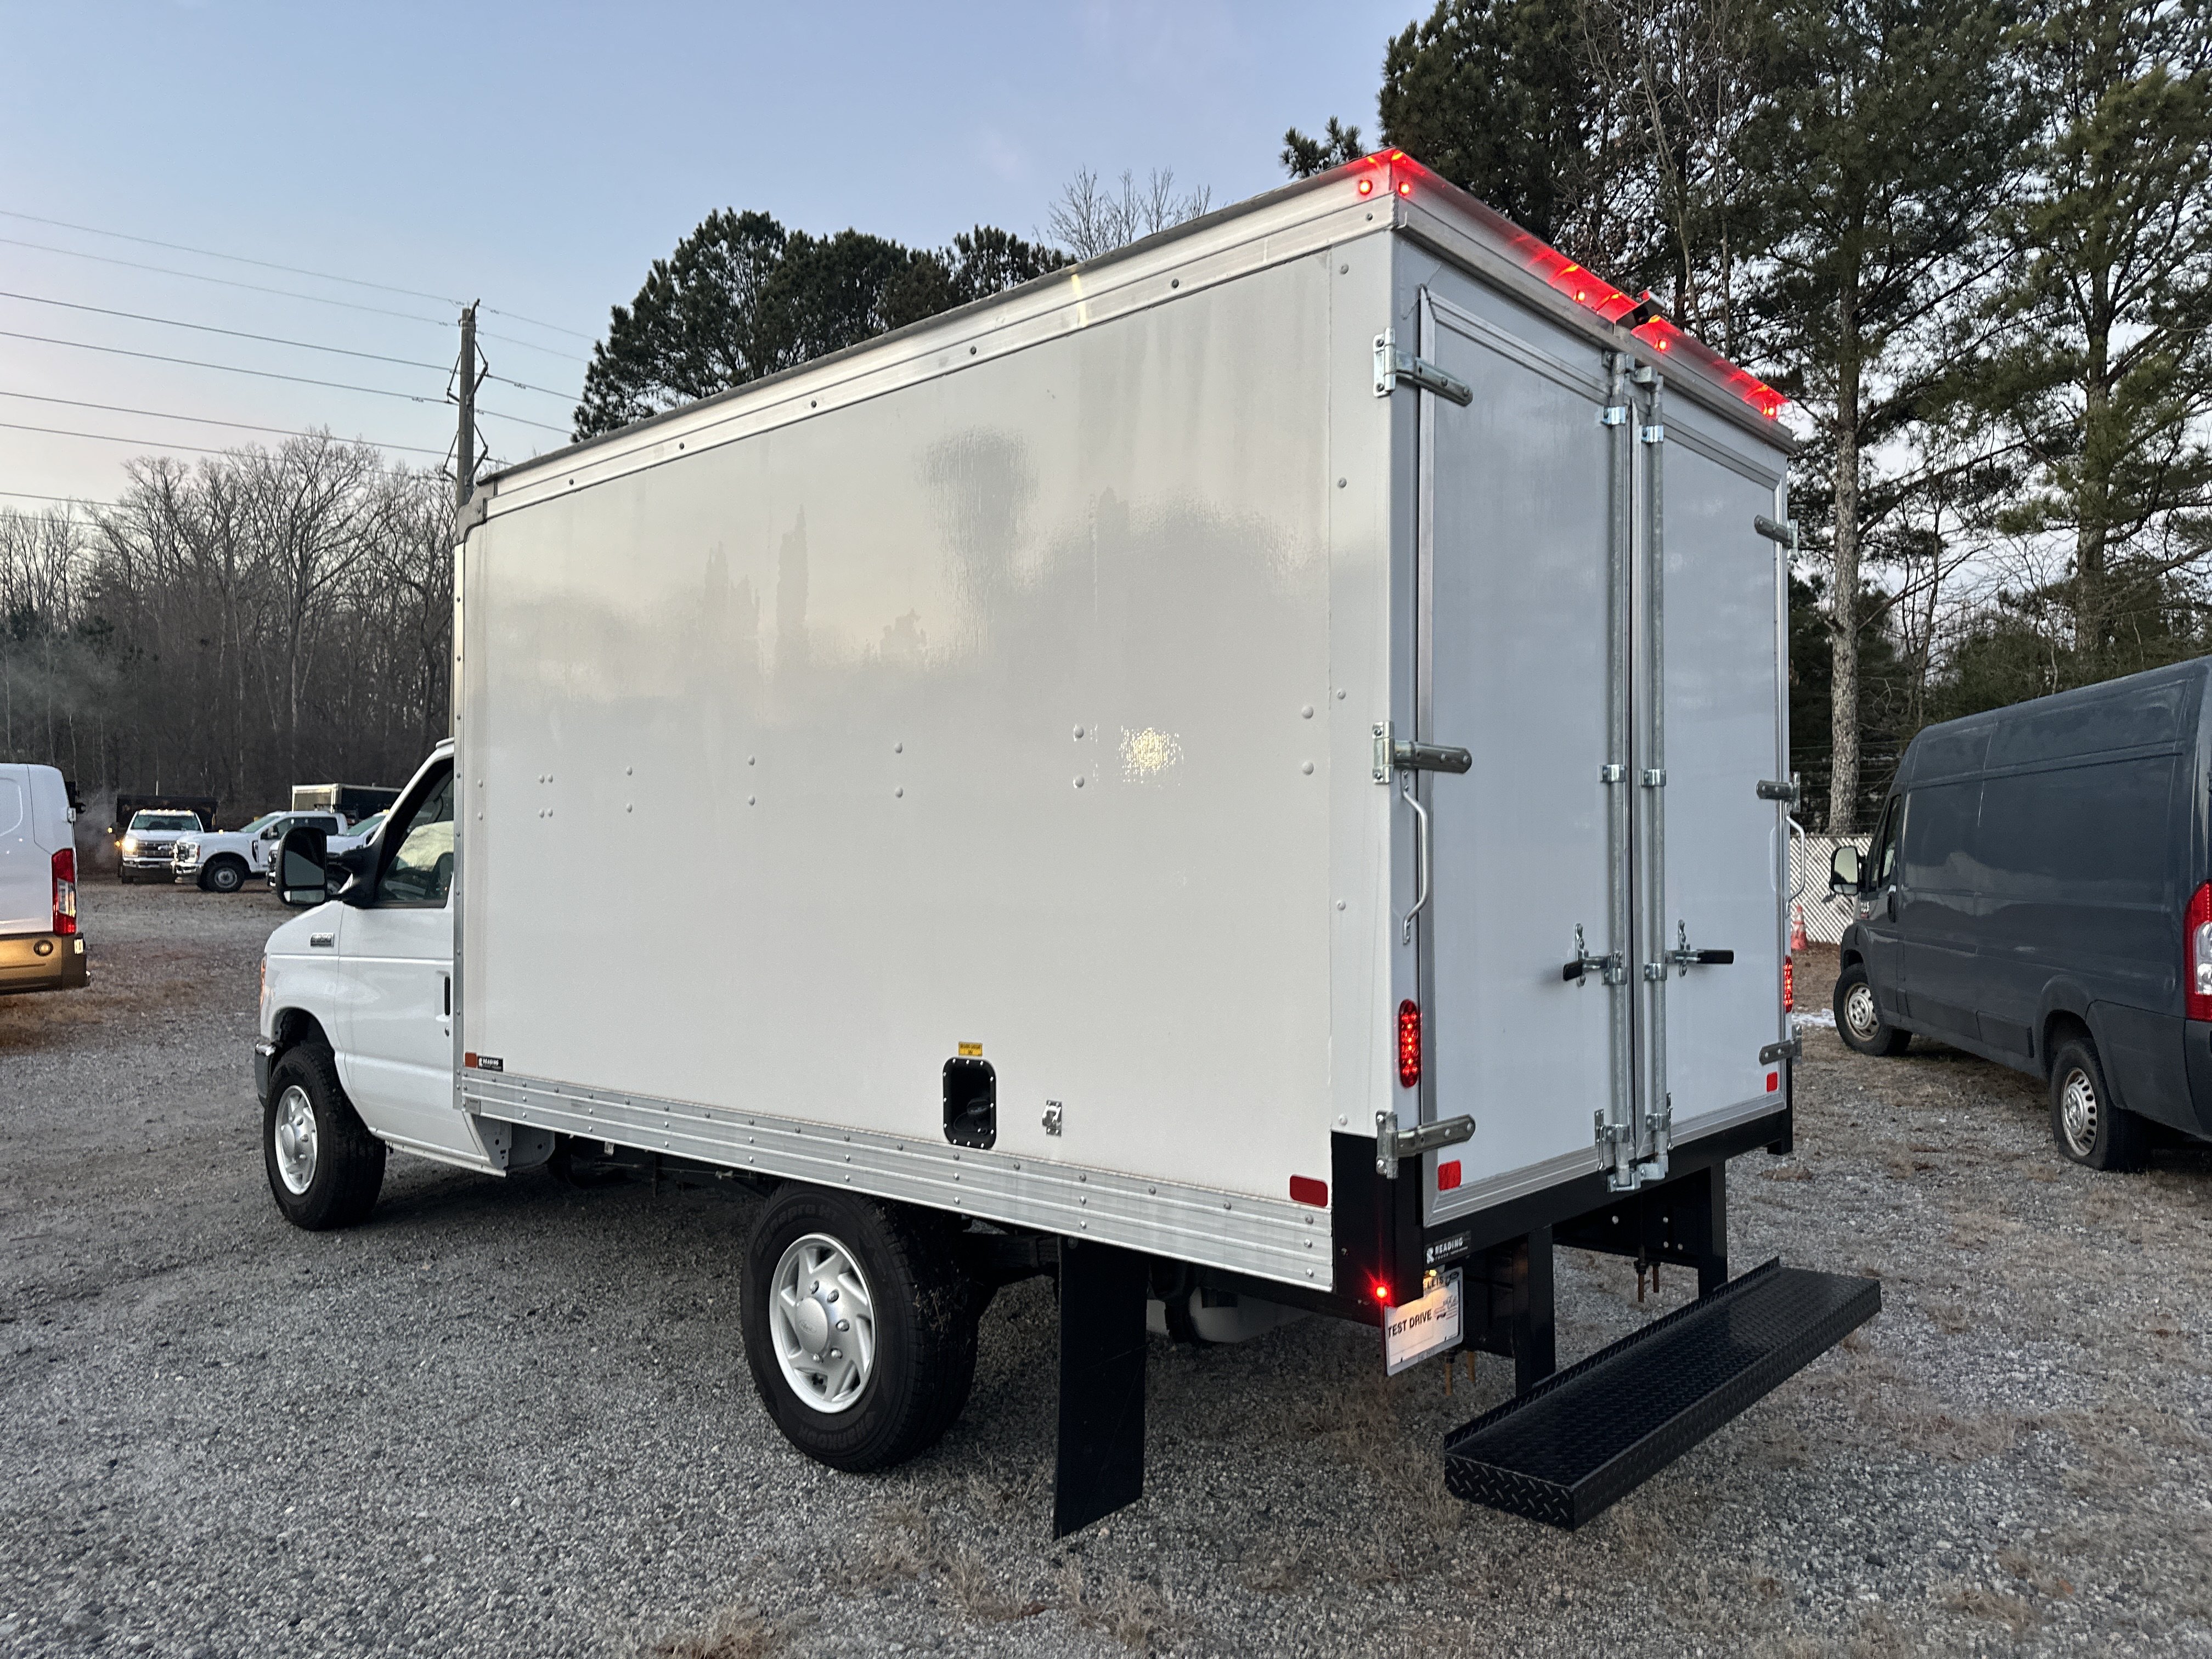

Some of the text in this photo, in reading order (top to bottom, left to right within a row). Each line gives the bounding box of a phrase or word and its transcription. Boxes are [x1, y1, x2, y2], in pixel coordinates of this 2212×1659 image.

[1435, 1237, 1463, 1256] READING
[1388, 1322, 1407, 1338] TEST
[1409, 1308, 1432, 1329] DRIVE
